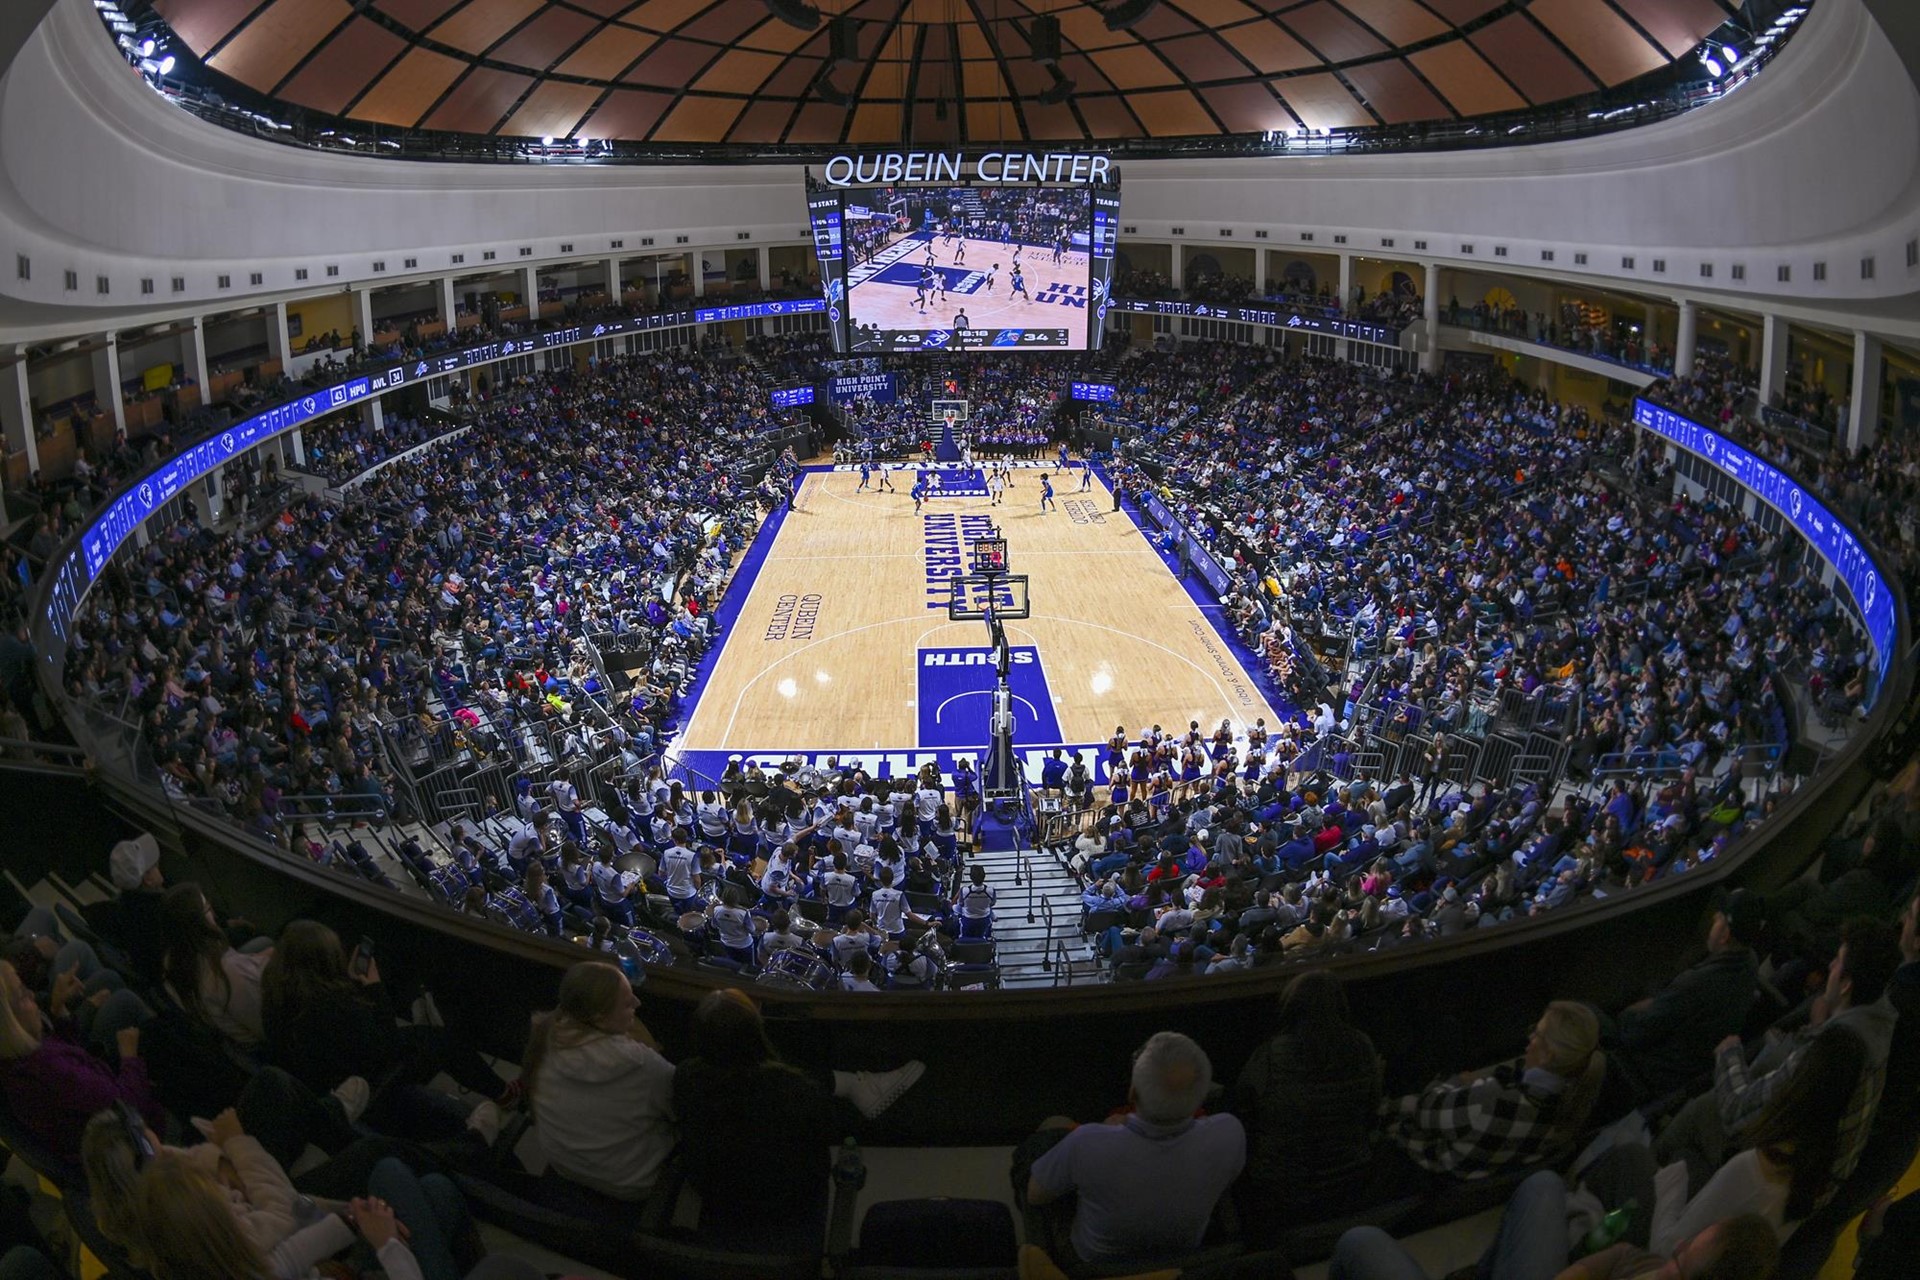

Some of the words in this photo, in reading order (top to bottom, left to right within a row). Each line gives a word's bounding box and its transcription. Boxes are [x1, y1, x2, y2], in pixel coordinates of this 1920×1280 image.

[825, 153, 962, 187] QUBEIN
[977, 153, 1110, 184] CENTER
[335, 390, 342, 400] 43
[350, 383, 366, 397] HPU
[373, 377, 386, 390] AVL
[393, 373, 400, 381] 34
[835, 382, 888, 393] UNIVERSITY
[836, 377, 858, 386] HIGH
[860, 375, 887, 384] POINT
[764, 594, 798, 641] CENTER
[791, 594, 822, 640] QUBEIN
